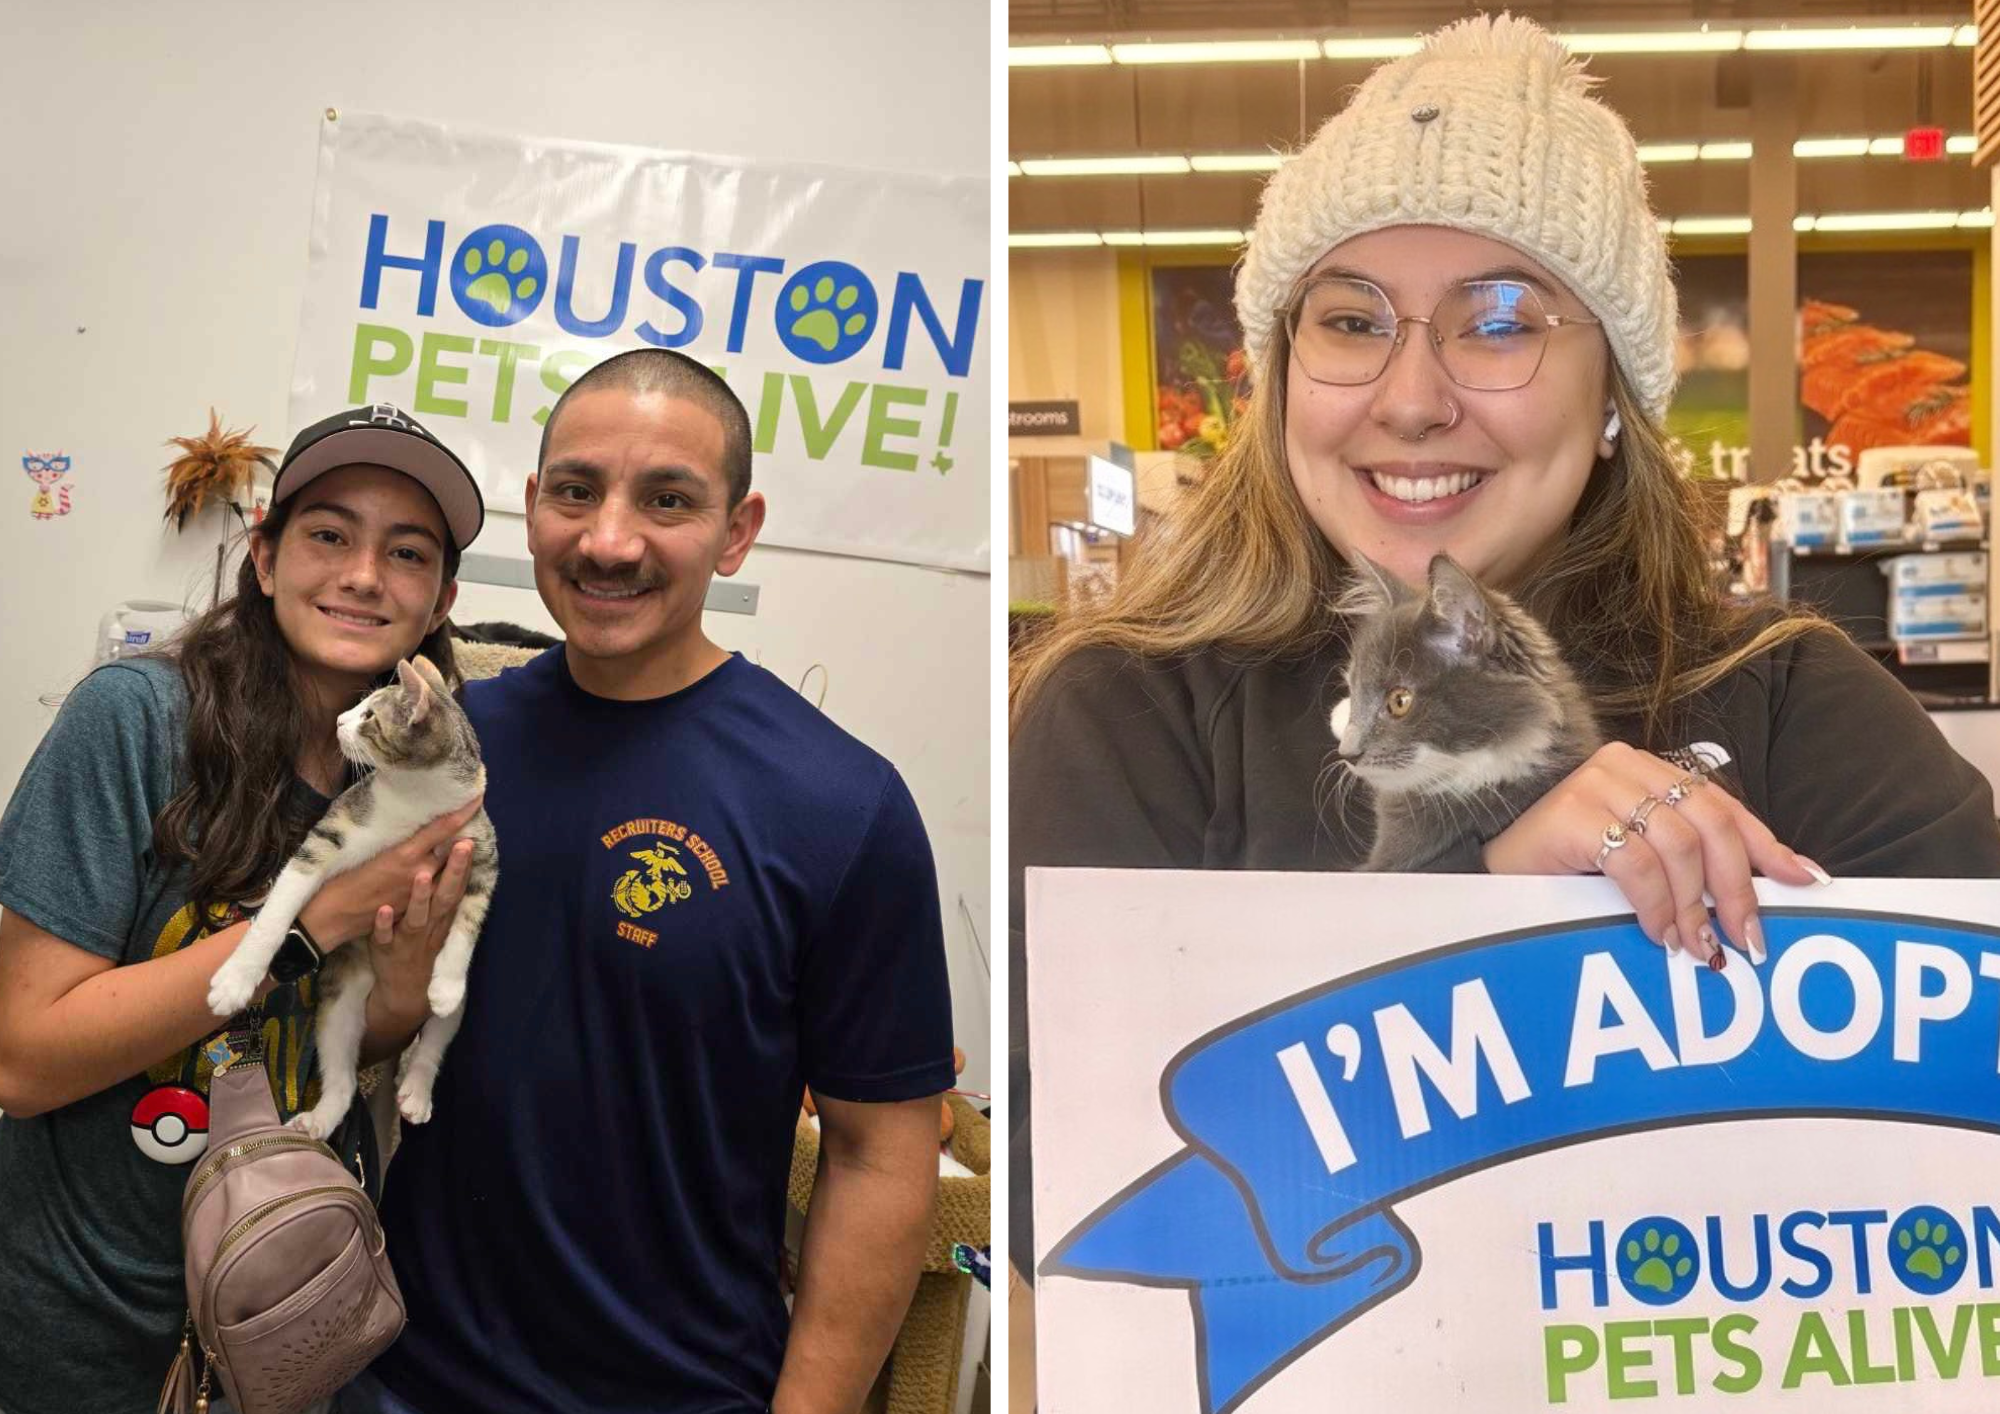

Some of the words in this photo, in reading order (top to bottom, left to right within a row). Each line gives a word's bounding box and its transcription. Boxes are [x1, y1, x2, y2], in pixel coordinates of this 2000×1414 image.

[358, 213, 985, 377] HOUSTON
[601, 818, 688, 849] RECRUITERS
[684, 833, 730, 890] SCHOOL
[617, 920, 659, 949] STAFF
[1563, 934, 2000, 1088] ADOP
[1544, 1313, 1763, 1403] PETS
